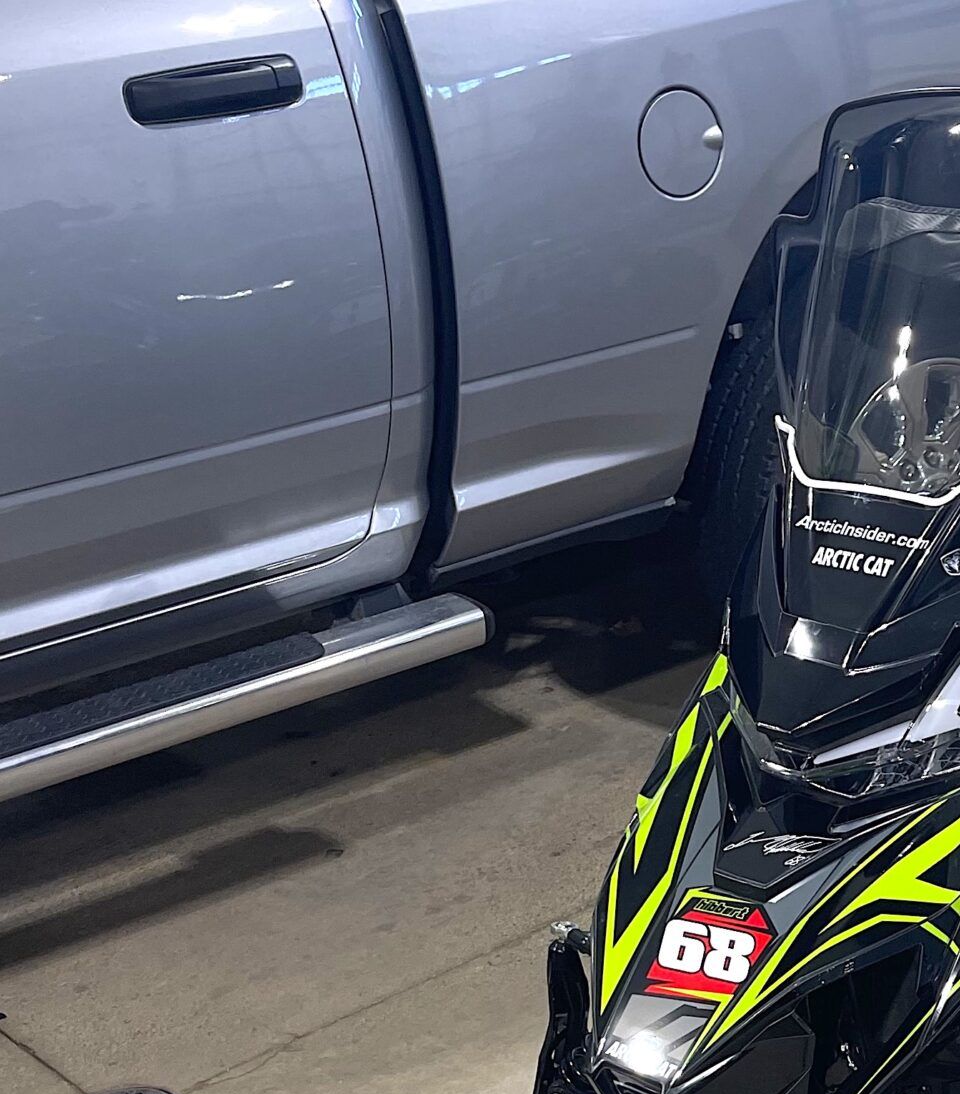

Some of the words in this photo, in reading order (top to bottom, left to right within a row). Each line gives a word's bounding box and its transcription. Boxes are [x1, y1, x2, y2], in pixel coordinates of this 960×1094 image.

[795, 514, 930, 550] ArcticInsider.com
[811, 546, 862, 573] ARCTIC
[863, 555, 895, 578] CAT
[693, 898, 751, 919] hibbert
[656, 918, 756, 984] 68
